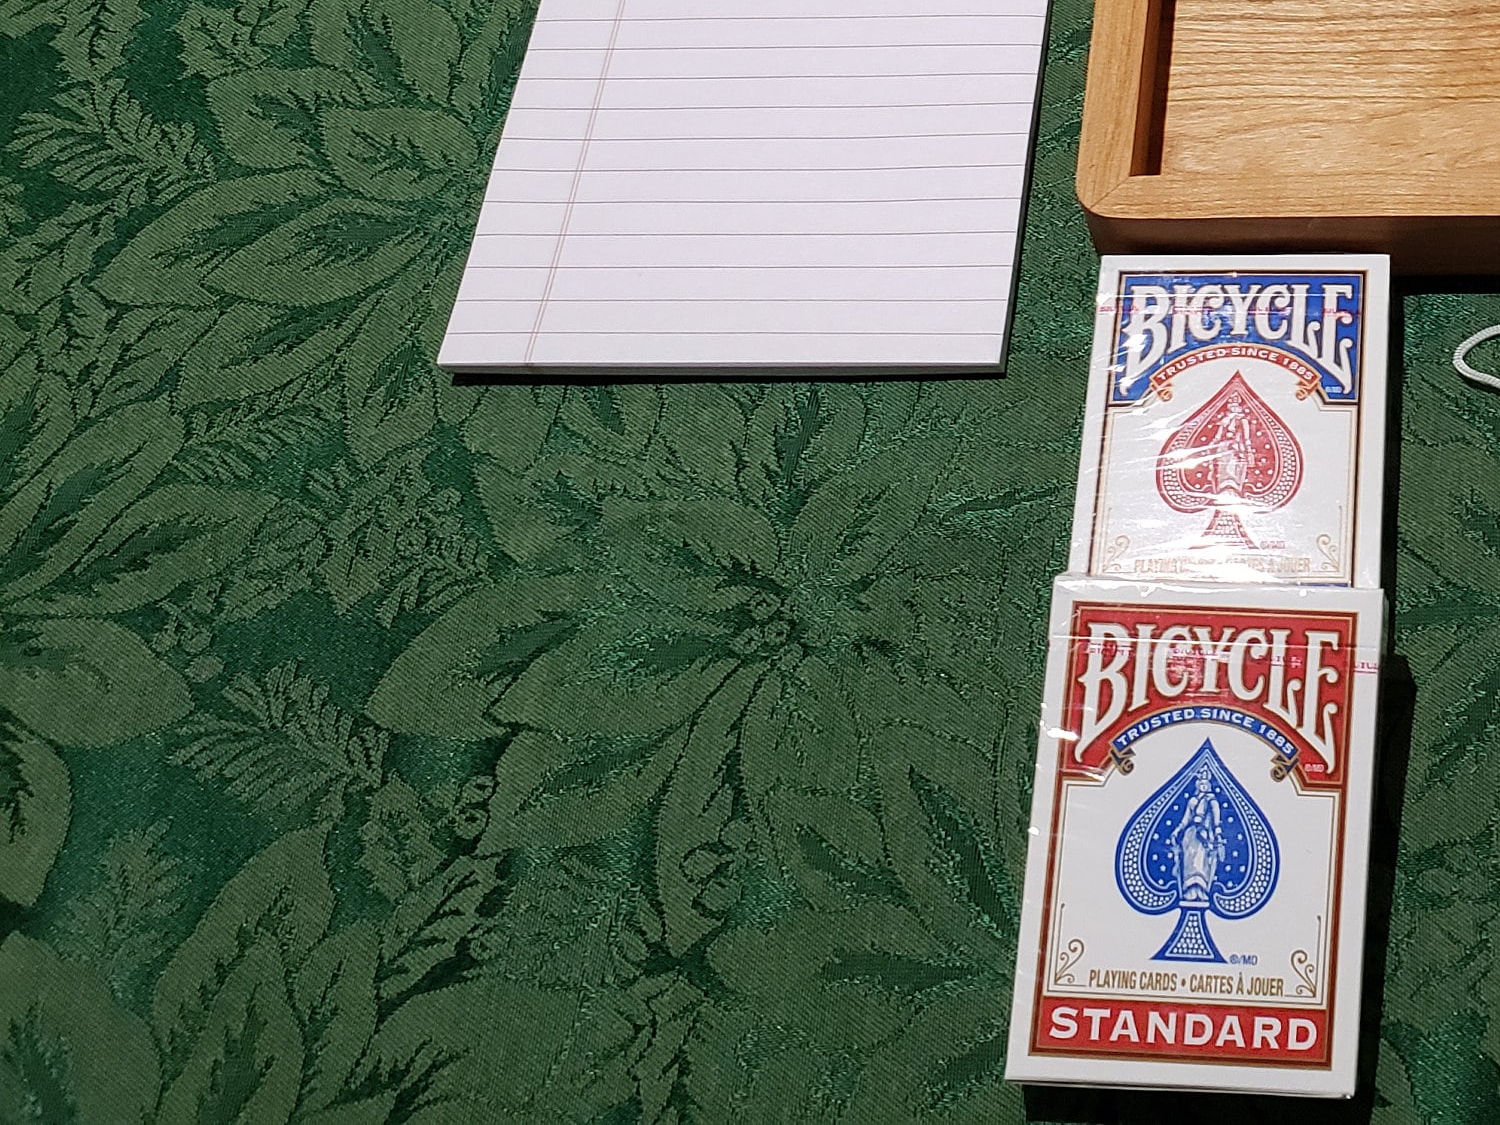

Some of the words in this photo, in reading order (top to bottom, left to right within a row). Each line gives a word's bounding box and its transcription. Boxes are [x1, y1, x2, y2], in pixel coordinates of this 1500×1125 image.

[1119, 283, 1354, 396] BICYCLE
[1157, 349, 1227, 381] TRUSTED
[1231, 347, 1278, 362] SINCE
[1282, 357, 1314, 381] 1885
[1073, 621, 1340, 774] BICYCLE
[1116, 709, 1195, 746] TRUSTED
[1200, 708, 1253, 728] SINCE
[1258, 725, 1294, 754] 1885
[1089, 969, 1137, 990] PLAYING
[1139, 972, 1178, 992] CARDS
[1189, 975, 1234, 995] CARTES
[1236, 971, 1245, 995] À
[1246, 977, 1284, 997] JOUER
[1049, 1005, 1318, 1052] STANDARD
